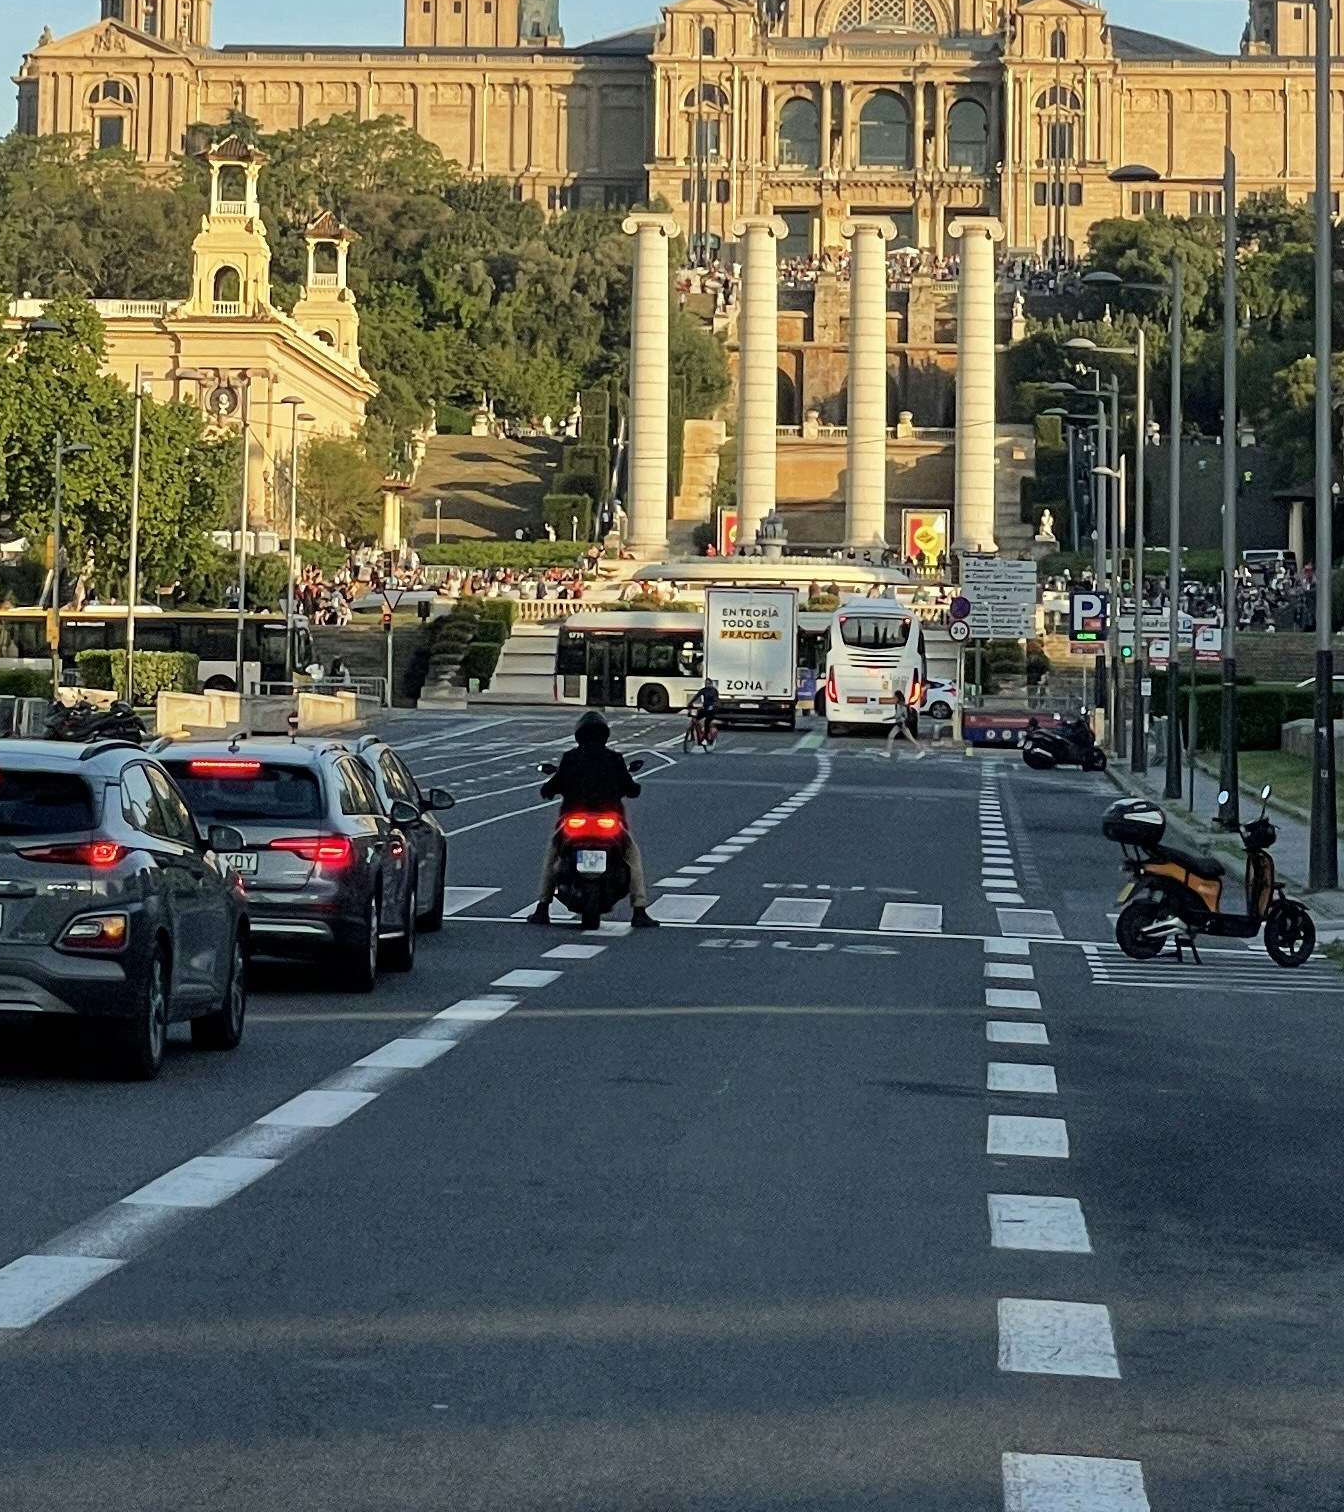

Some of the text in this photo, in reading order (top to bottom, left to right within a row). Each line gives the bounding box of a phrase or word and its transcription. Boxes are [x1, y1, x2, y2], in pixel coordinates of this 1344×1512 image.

[722, 608, 736, 616] EN
[1074, 594, 1101, 630] P
[722, 619, 770, 628] TODO ES
[953, 627, 965, 635] 30
[726, 680, 763, 690] ZONA
